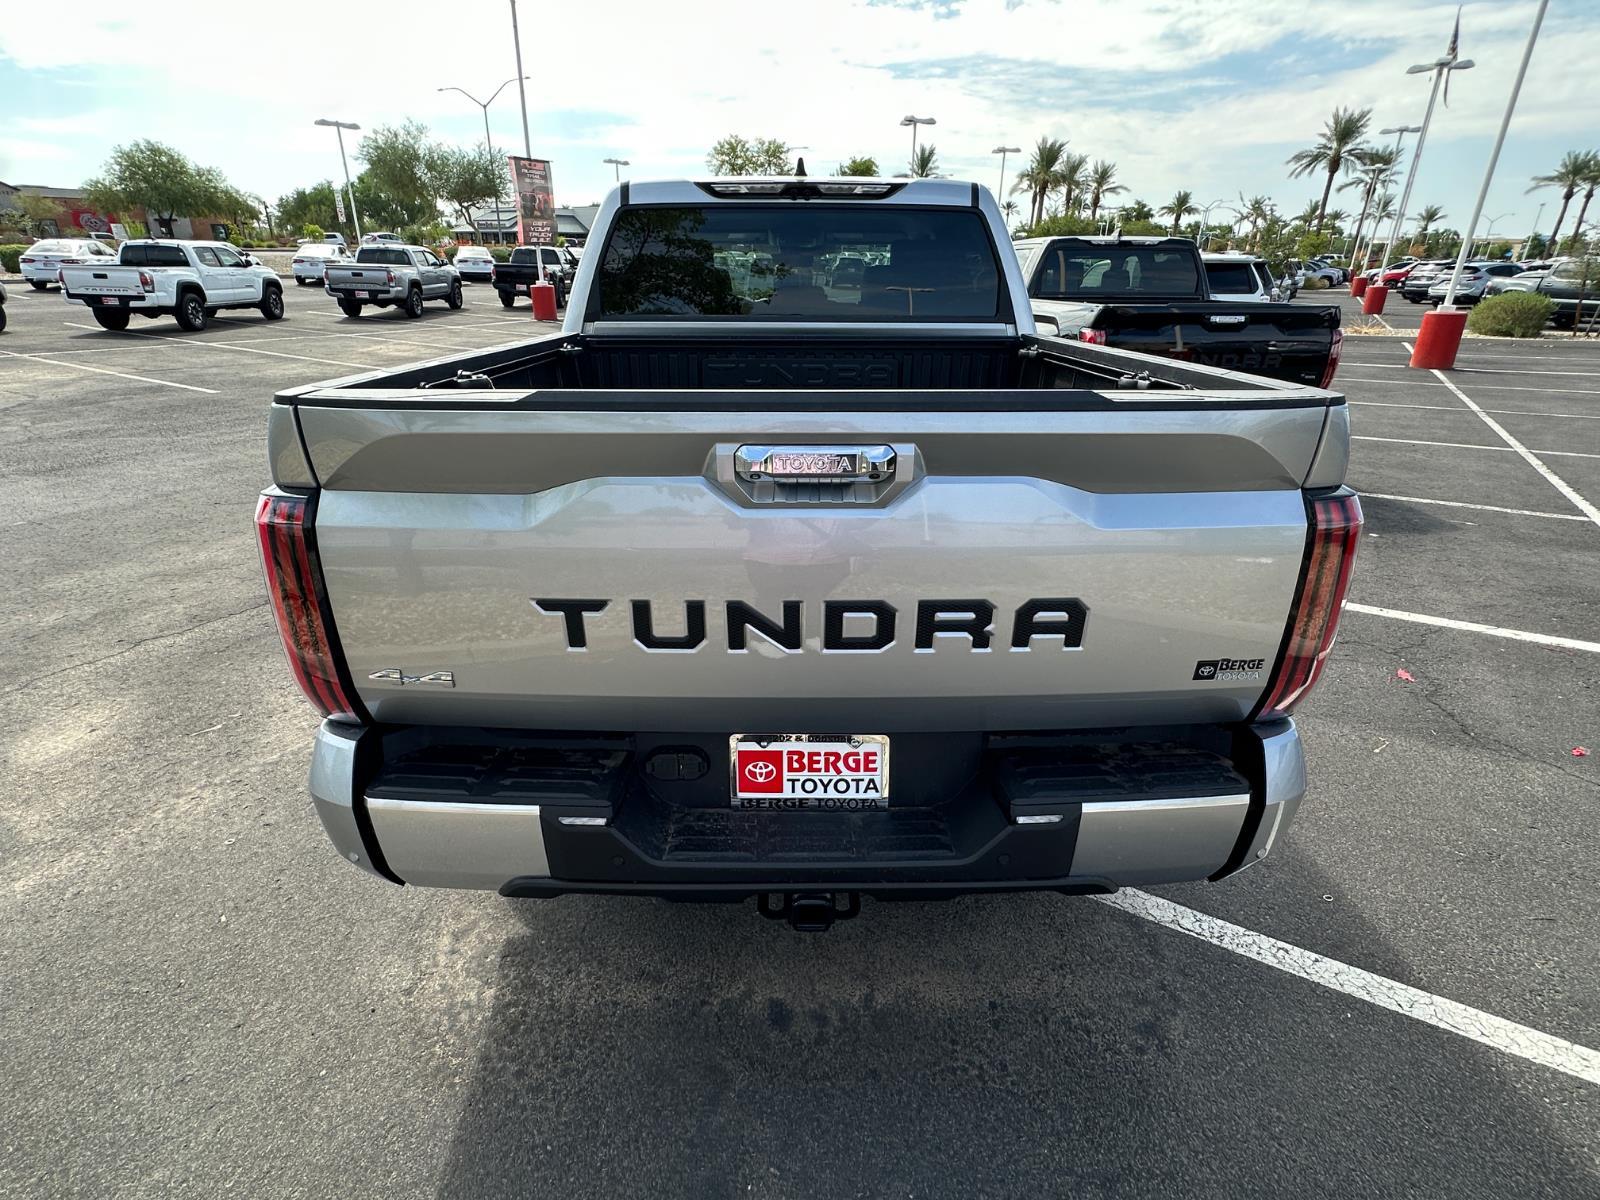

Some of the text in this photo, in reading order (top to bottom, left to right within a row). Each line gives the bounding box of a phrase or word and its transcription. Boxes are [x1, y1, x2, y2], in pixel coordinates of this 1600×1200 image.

[780, 456, 852, 472] TOYOTA
[529, 597, 1091, 655] TUNDRA
[1218, 657, 1265, 671] BERGE
[1216, 671, 1260, 681] TOYOTA
[786, 750, 878, 775] BERGE
[786, 777, 880, 794] TOYOTA
[740, 798, 879, 810] BERGE TOYOTA
